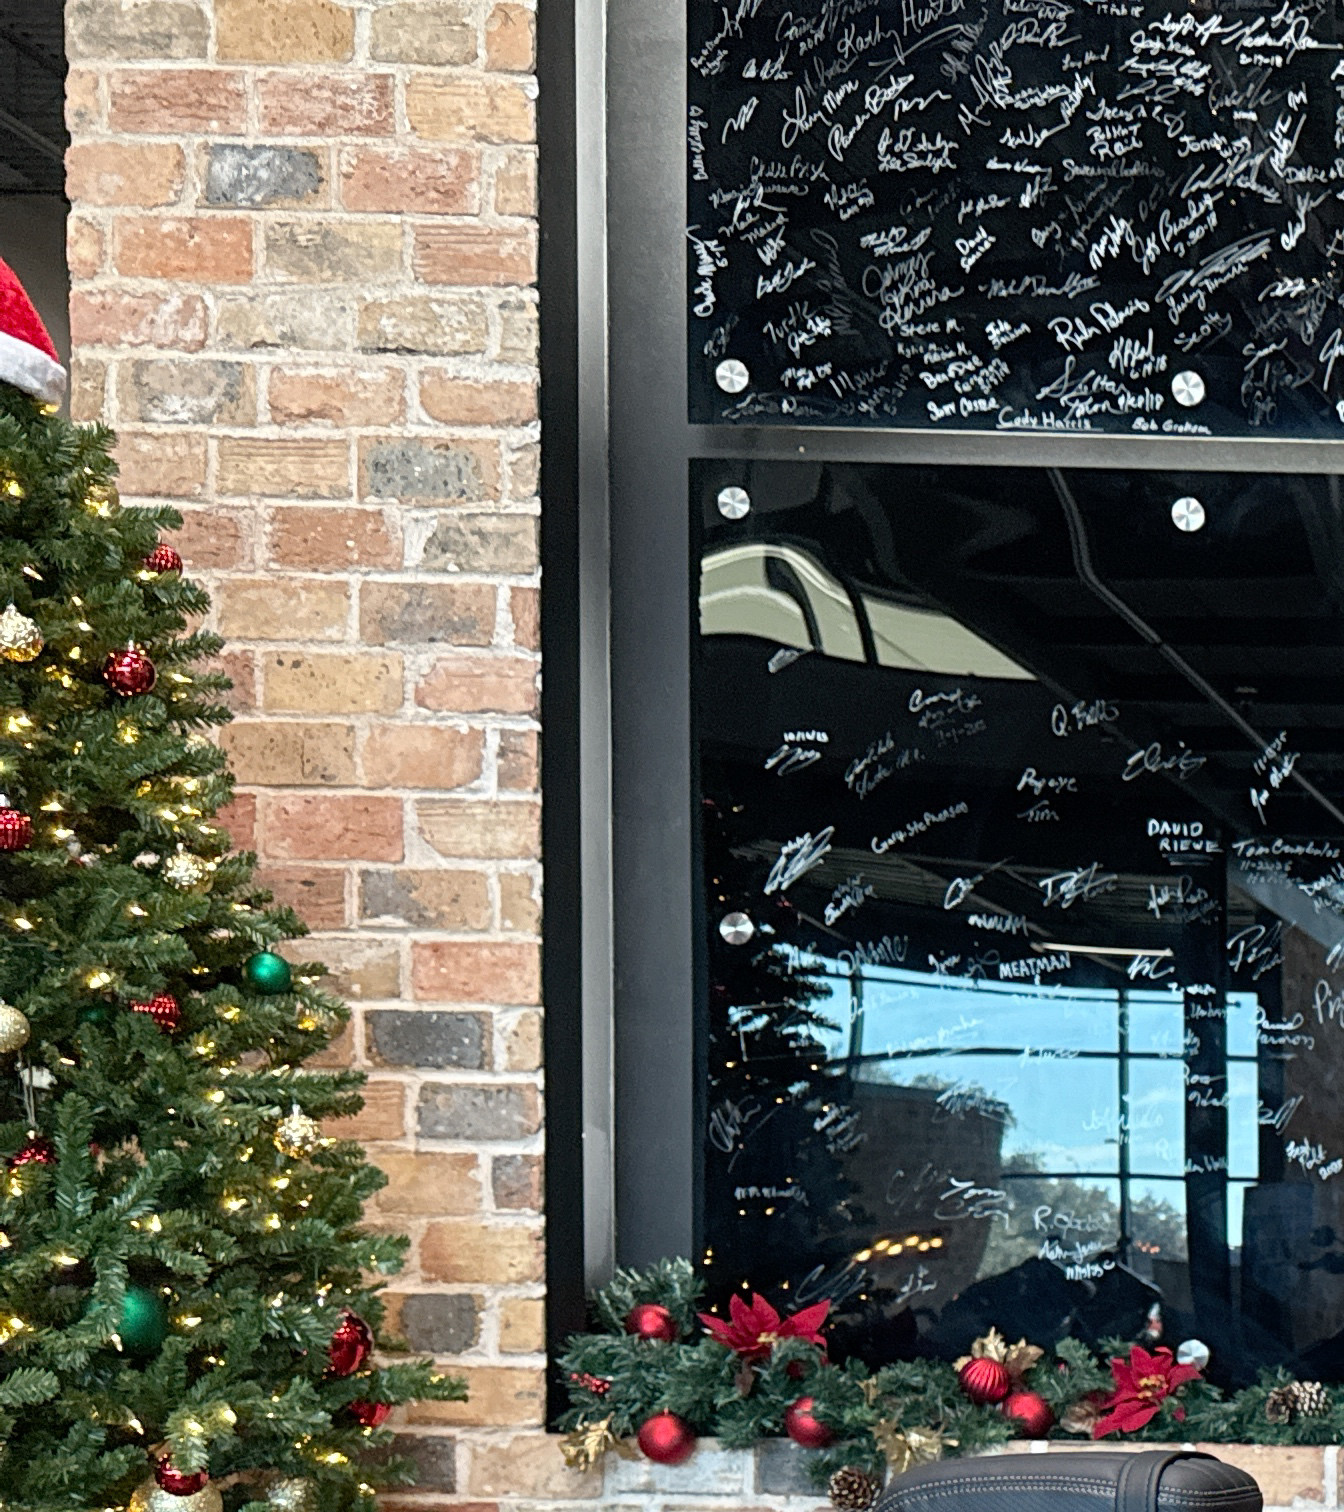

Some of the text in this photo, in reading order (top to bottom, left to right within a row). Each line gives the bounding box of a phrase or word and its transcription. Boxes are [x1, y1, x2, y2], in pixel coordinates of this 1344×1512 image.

[997, 406, 1038, 427] Cody
[1147, 818, 1203, 836] DAVID
[999, 952, 1071, 978] MEATMAN
